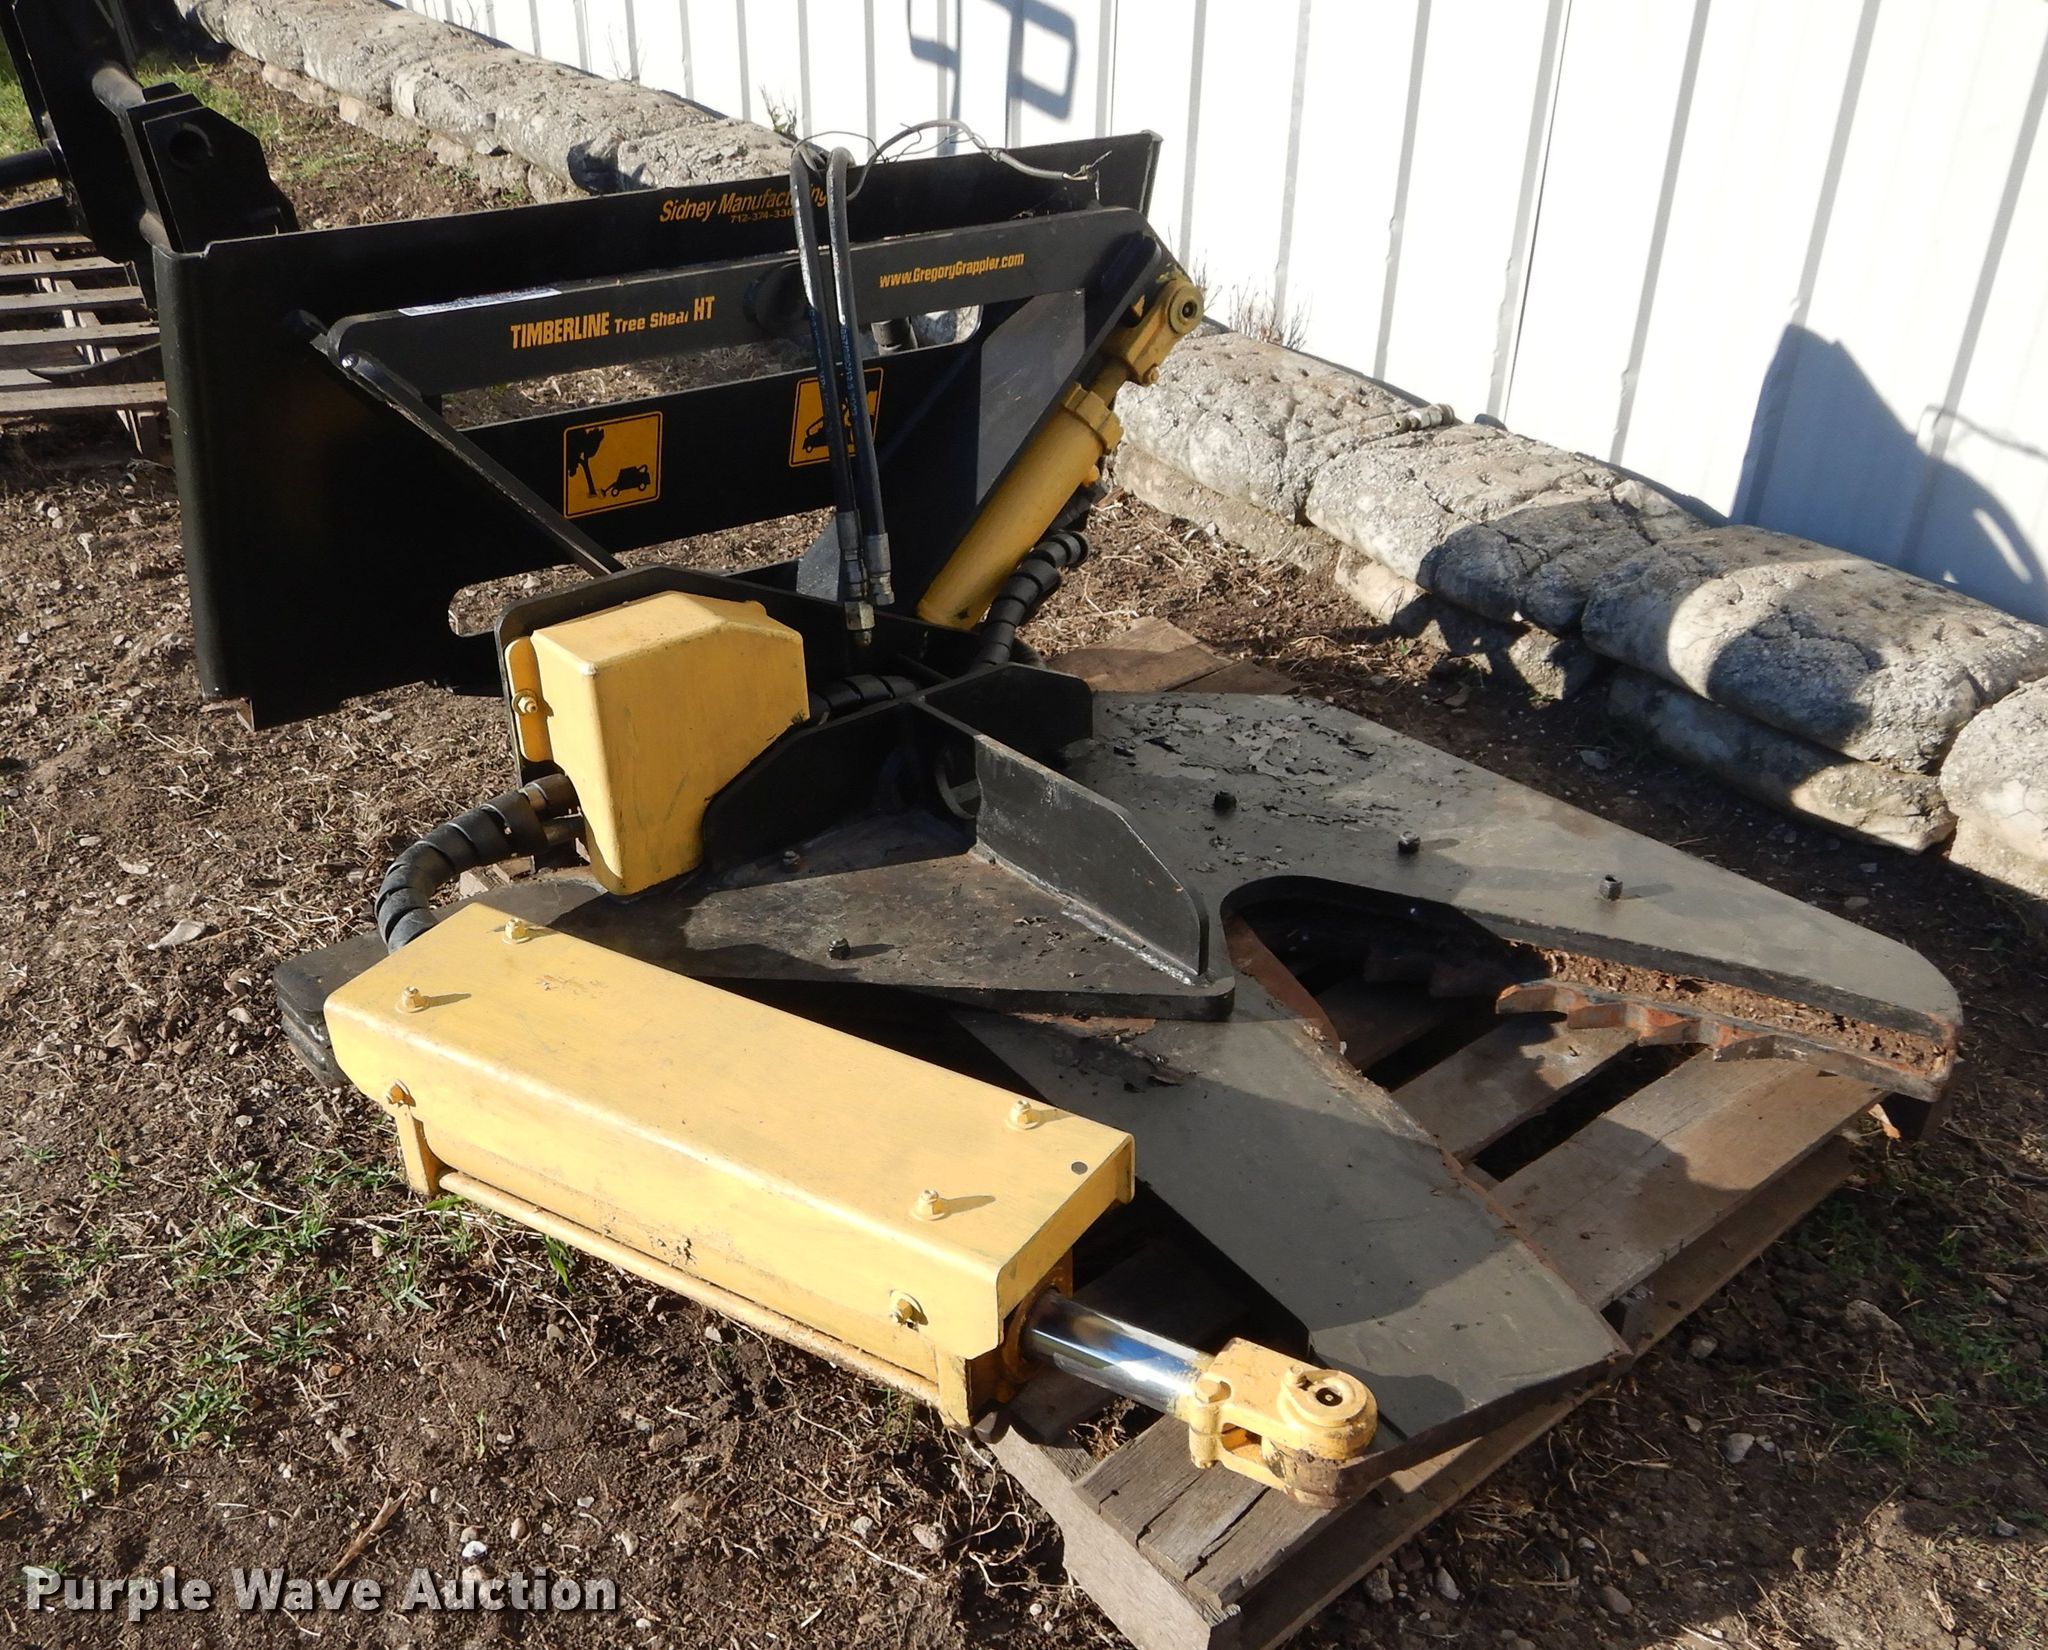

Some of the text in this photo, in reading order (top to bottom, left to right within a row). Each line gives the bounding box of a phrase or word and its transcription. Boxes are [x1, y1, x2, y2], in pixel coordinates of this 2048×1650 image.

[659, 186, 828, 223] Sidney Manufactng
[879, 253, 1025, 289] www.GregoryGrappler.com
[510, 311, 610, 349] TIMBERLINE
[614, 317, 646, 334] Tree
[693, 295, 715, 321] HT
